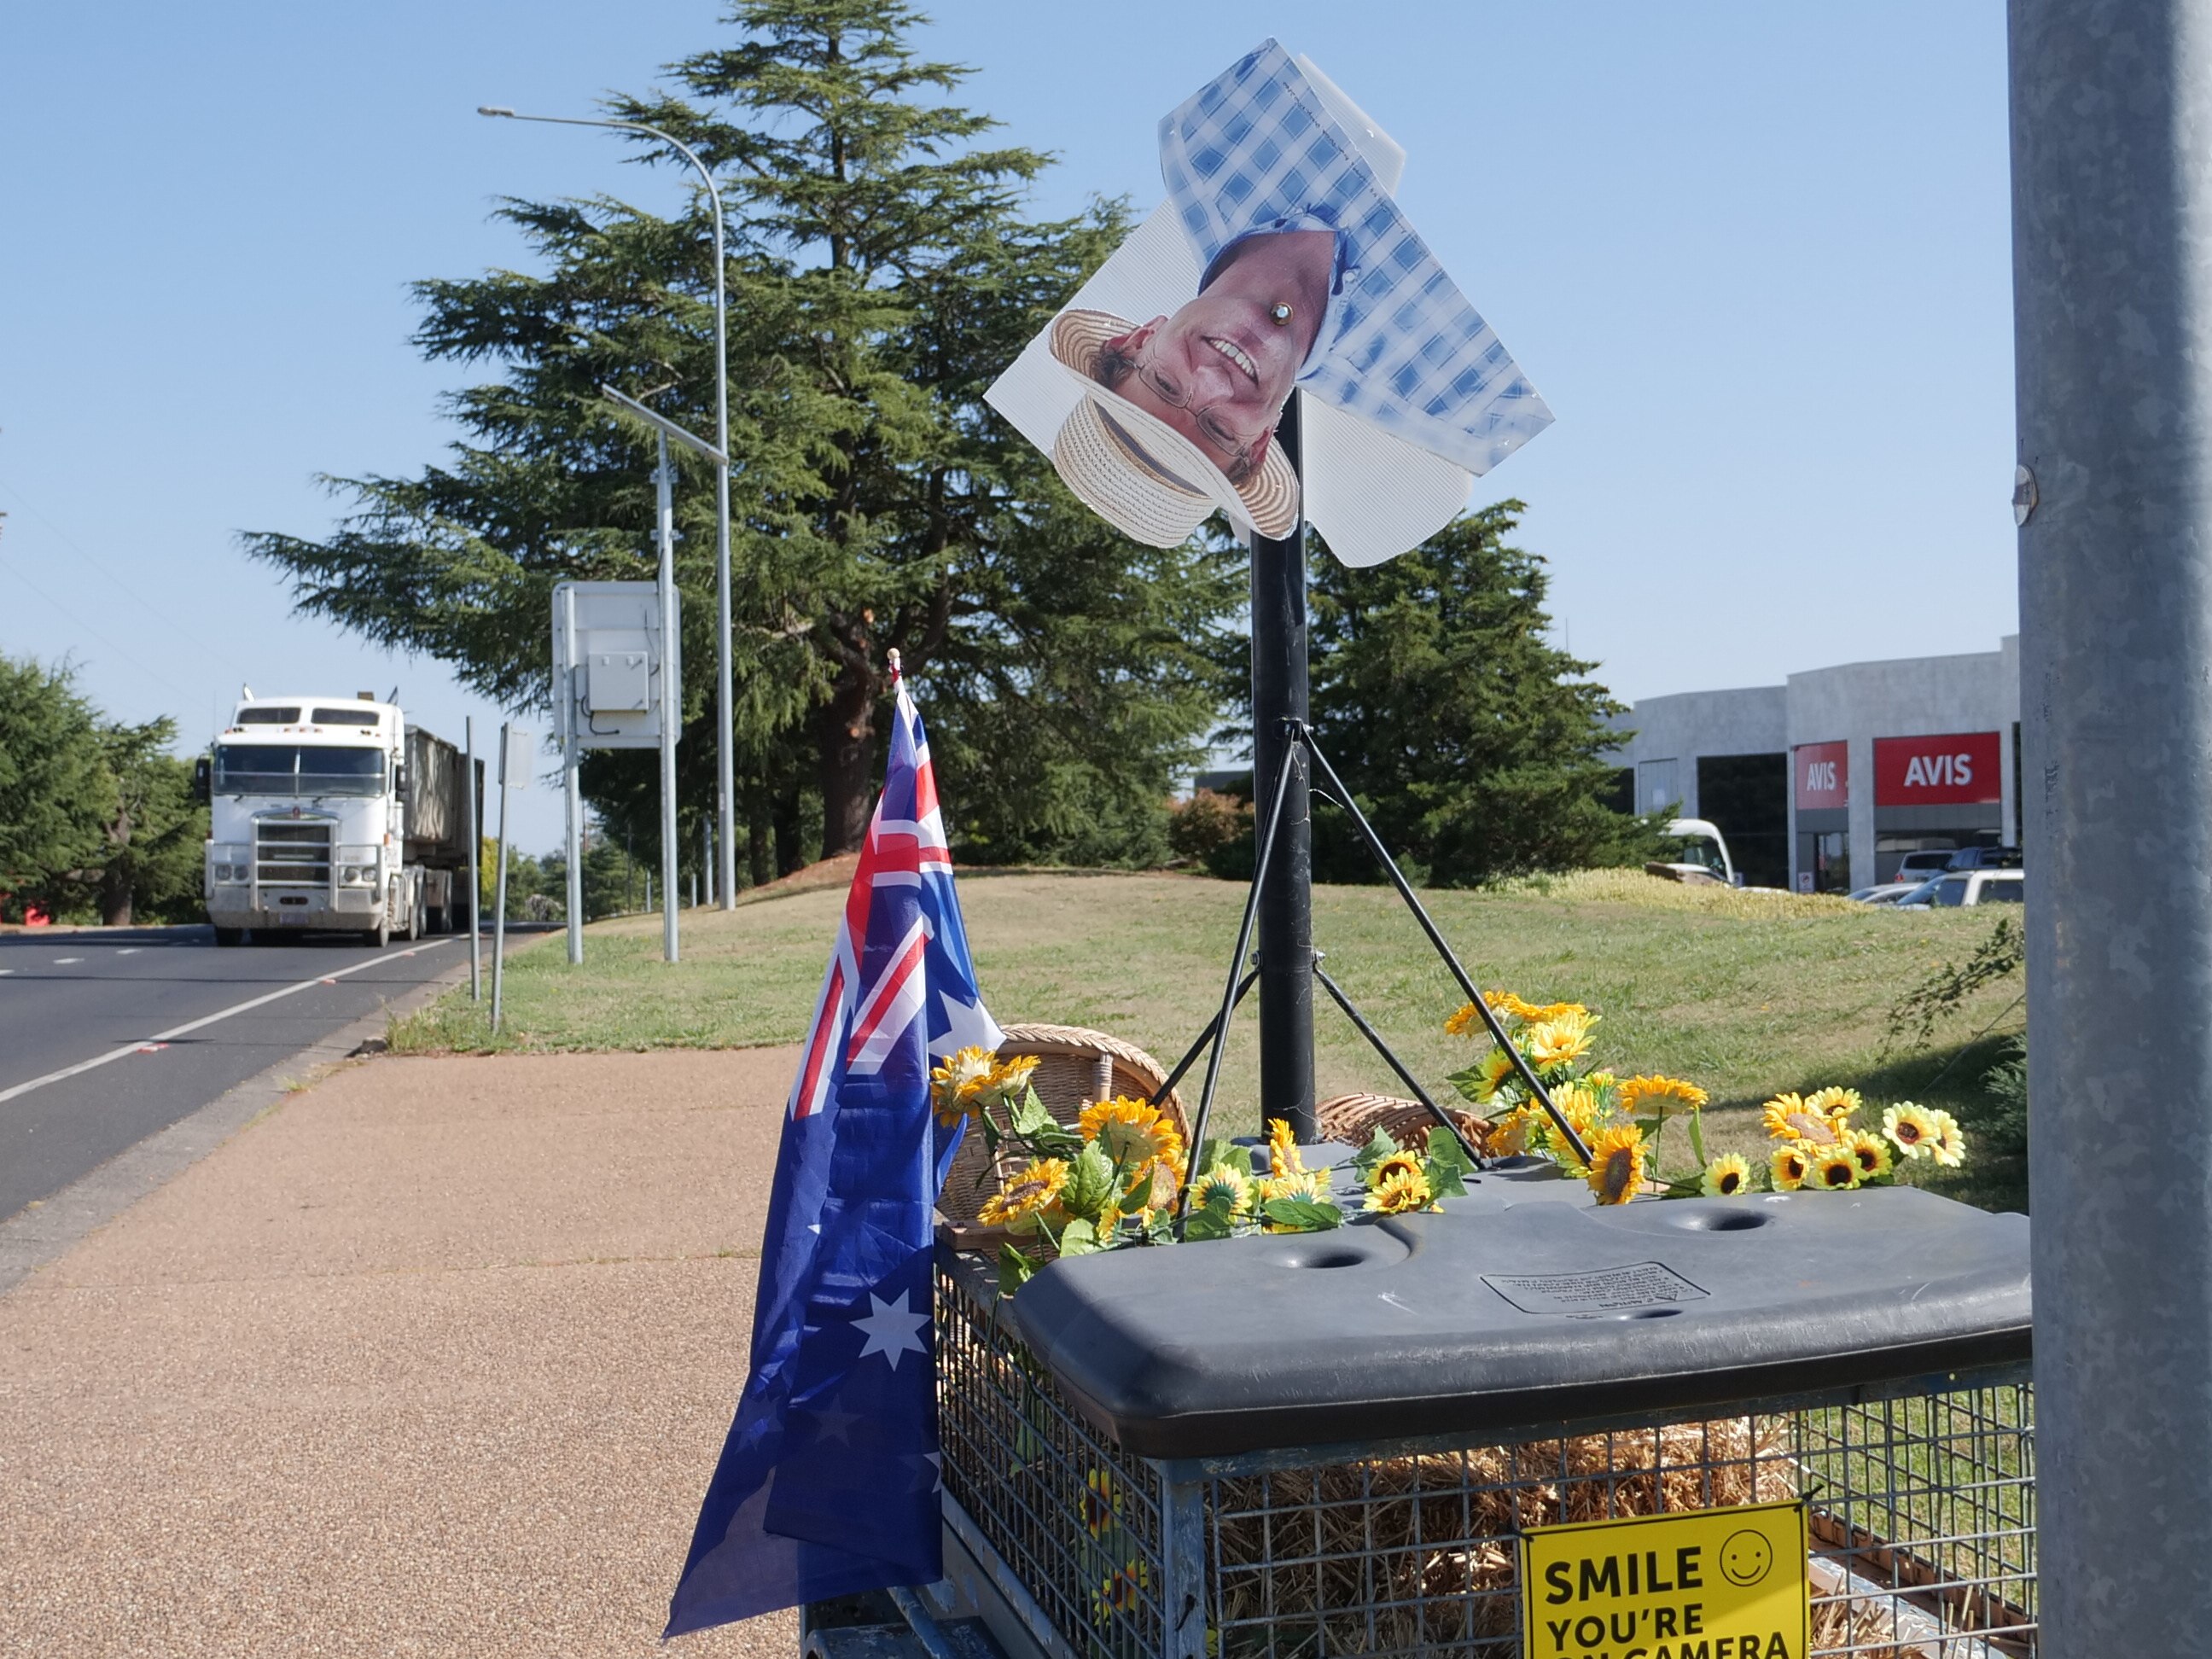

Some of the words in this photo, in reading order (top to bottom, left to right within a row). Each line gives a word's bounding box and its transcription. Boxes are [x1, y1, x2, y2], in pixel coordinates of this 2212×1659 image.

[1806, 762, 1835, 791] AVIS
[1904, 754, 1972, 788] AVIS
[1545, 1546, 1703, 1604] SMILE
[1546, 1604, 1703, 1651] YOU'RE
